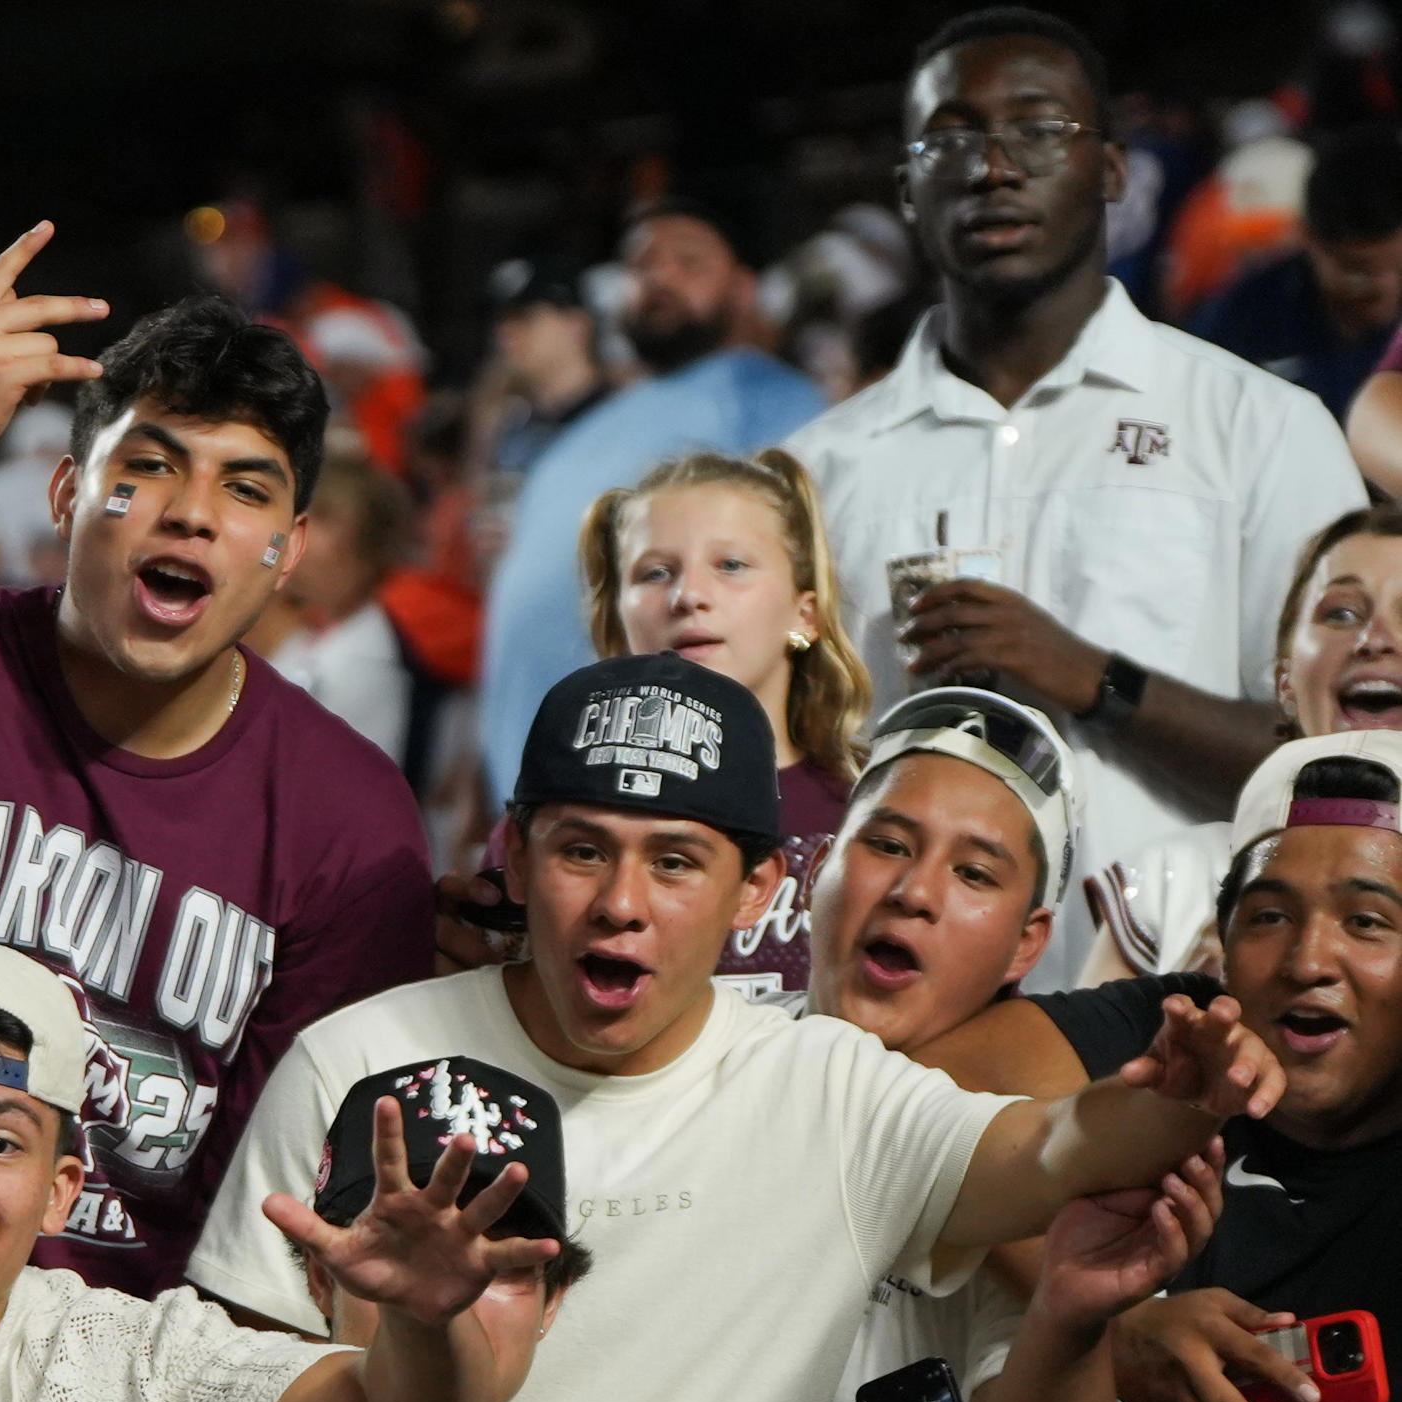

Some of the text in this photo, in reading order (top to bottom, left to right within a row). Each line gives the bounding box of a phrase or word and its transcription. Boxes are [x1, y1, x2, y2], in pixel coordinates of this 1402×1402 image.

[639, 685, 682, 703] WORLD
[685, 696, 723, 723] SERIES
[572, 696, 724, 770] CHAMPS
